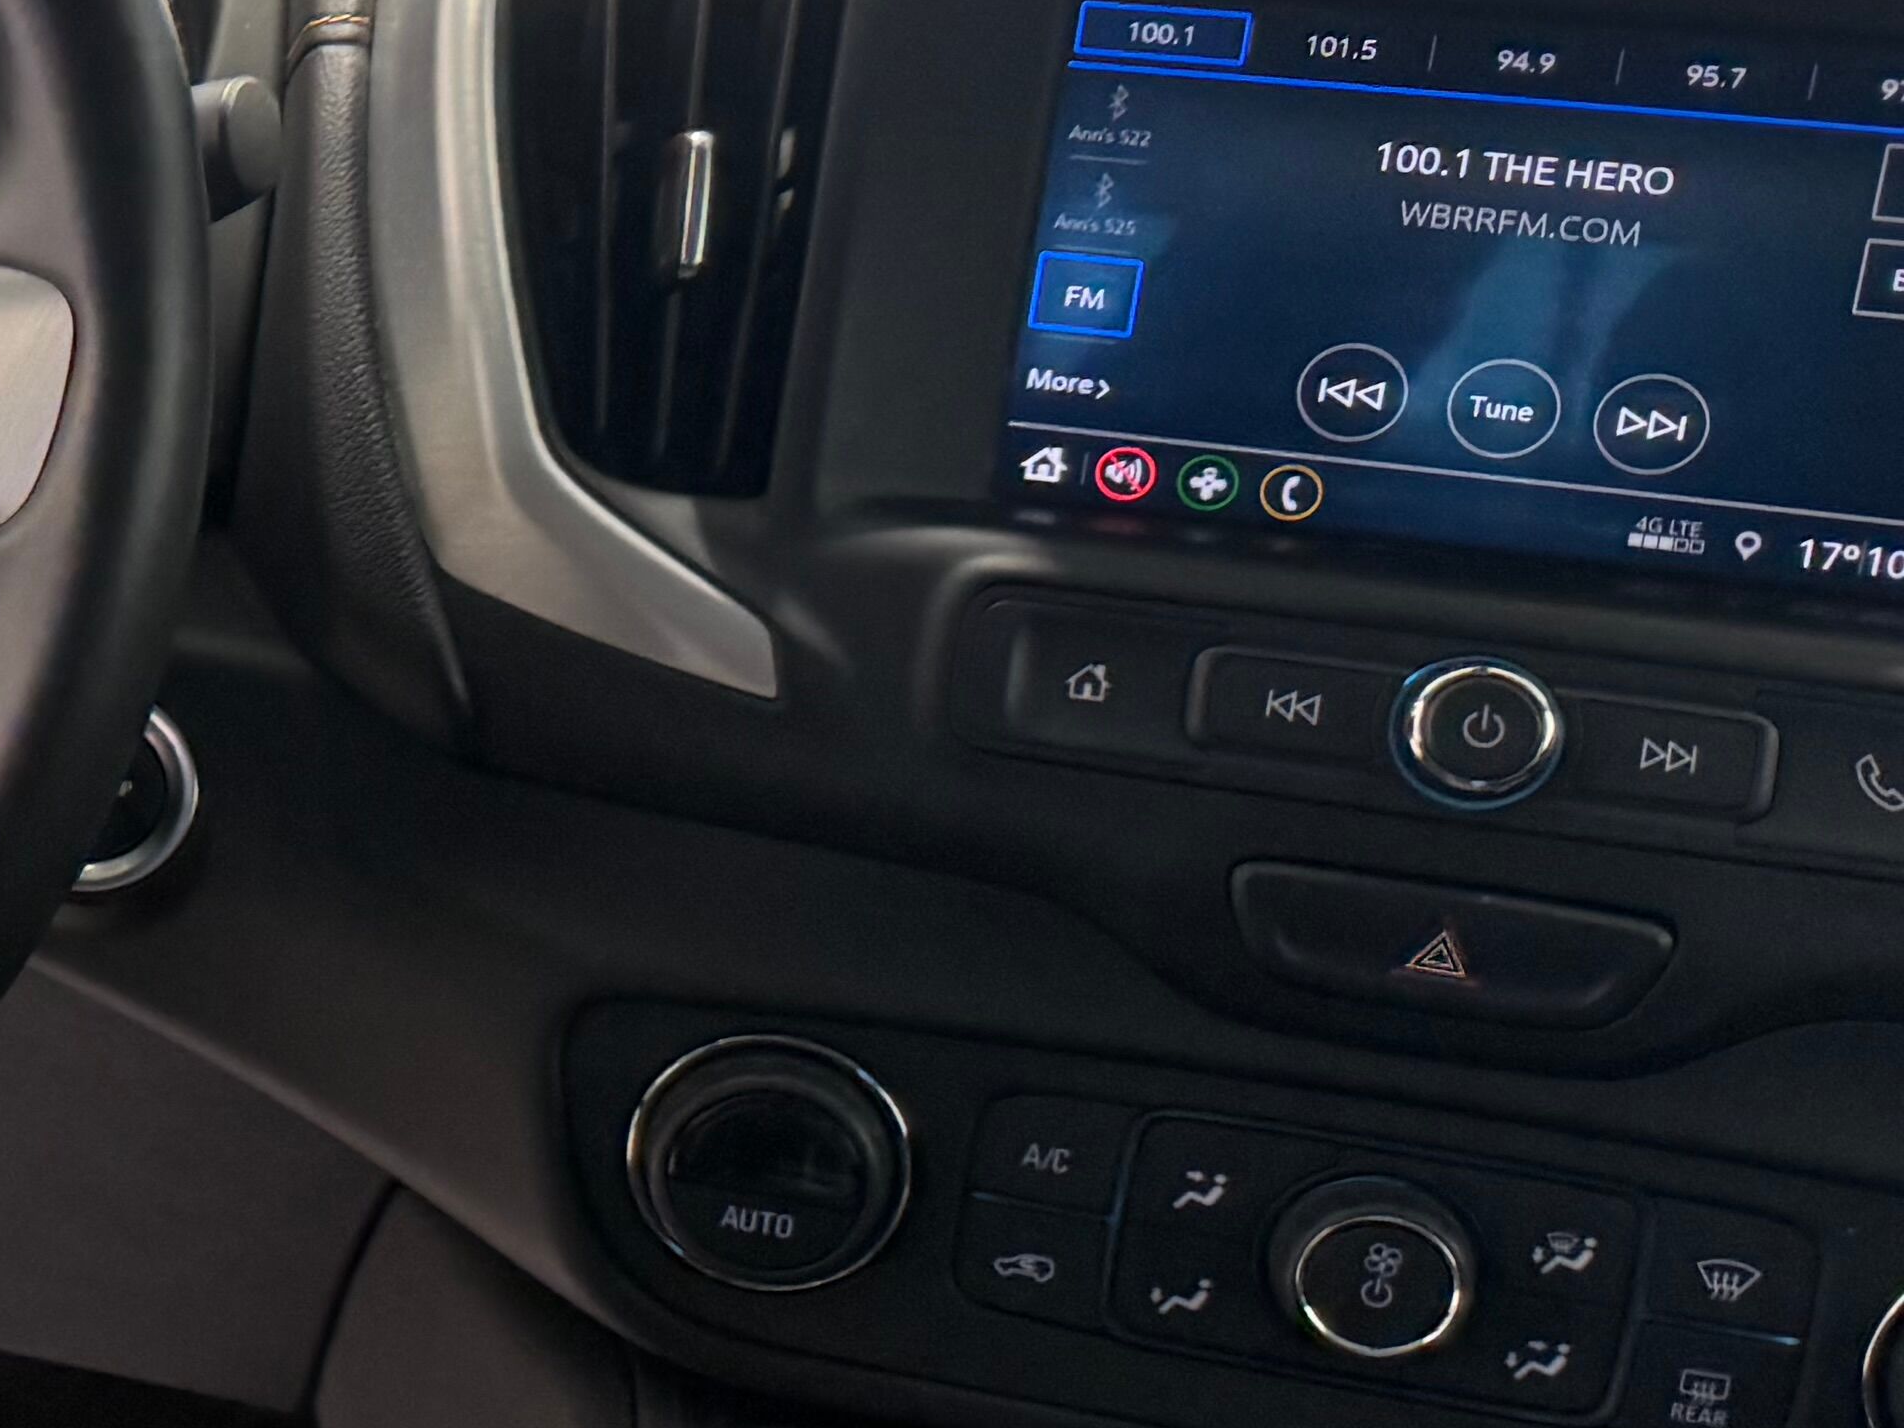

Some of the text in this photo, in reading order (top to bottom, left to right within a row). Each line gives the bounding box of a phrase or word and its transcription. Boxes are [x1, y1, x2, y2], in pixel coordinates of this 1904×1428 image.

[1128, 20, 1194, 48] 100.1
[1306, 34, 1378, 62] 101.5
[1496, 48, 1556, 75] 94.9
[1686, 64, 1747, 89] 95.7
[1068, 124, 1114, 143] Ann's
[1375, 141, 1675, 195] 100.1 THE HERO
[1054, 212, 1099, 232] Ann's
[1400, 200, 1641, 247] WBRRFM.COM
[1064, 284, 1104, 310] FM
[1470, 395, 1534, 423] Tune
[1636, 516, 1703, 537] 4G LTE
[1022, 1144, 1071, 1174] A/C
[721, 1204, 794, 1240] AUTO
[1670, 1401, 1728, 1428] REAR
